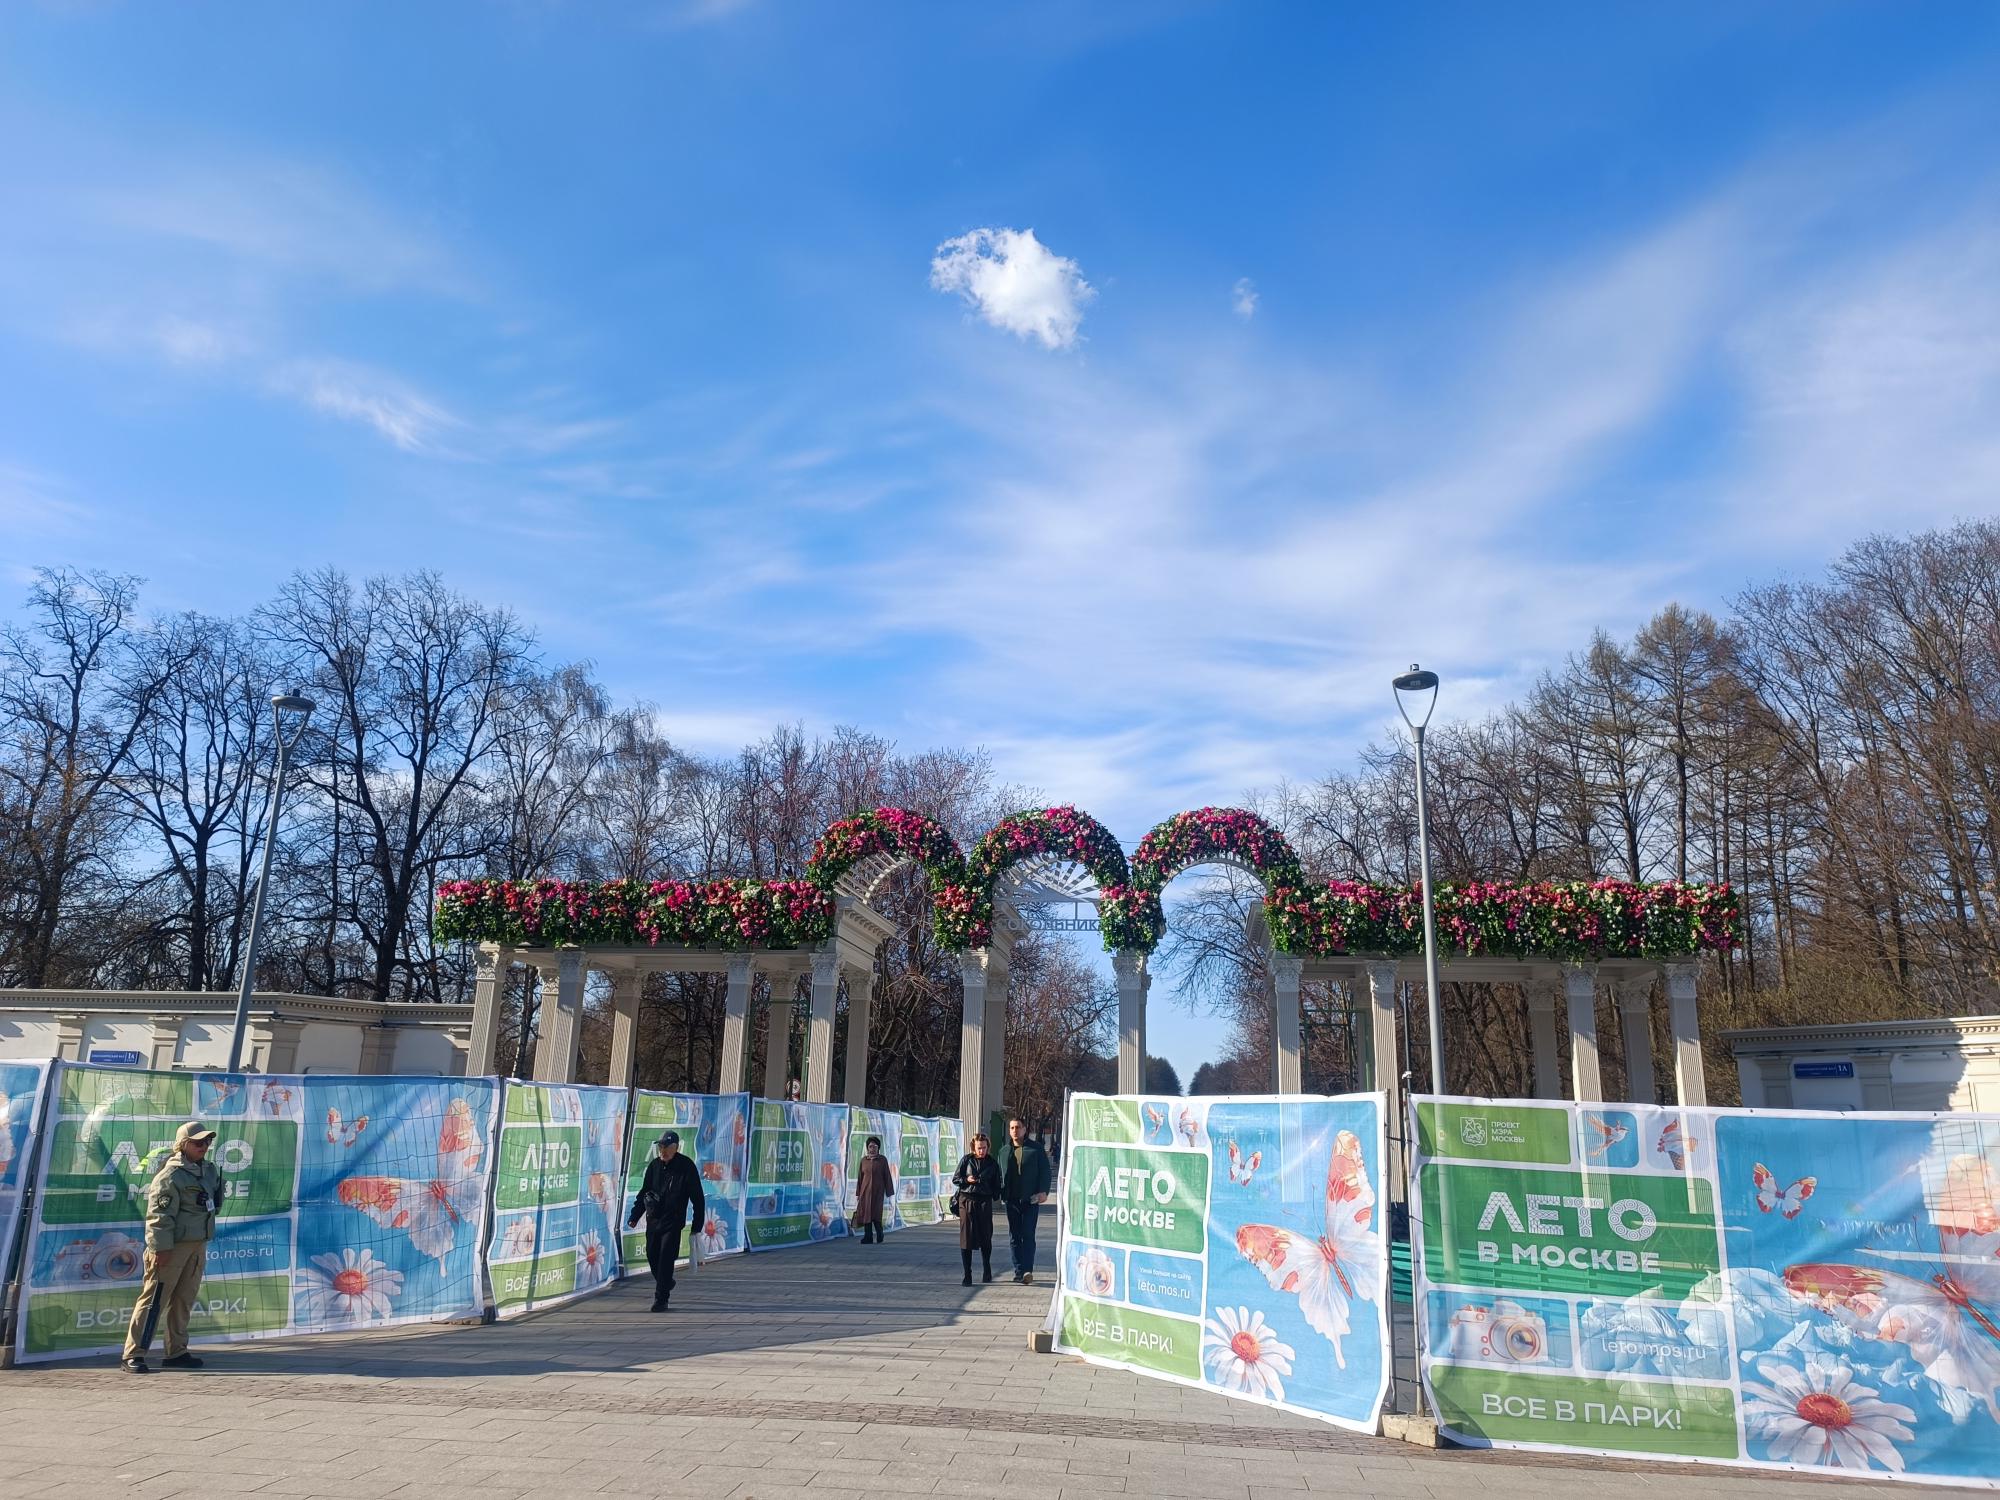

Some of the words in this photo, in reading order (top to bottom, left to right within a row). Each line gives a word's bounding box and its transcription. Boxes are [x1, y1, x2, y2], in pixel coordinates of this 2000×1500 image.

[521, 1141, 570, 1170] ЛЕТО
[767, 1140, 803, 1159] ЛЕТО
[765, 1163, 771, 1172] В
[97, 1184, 116, 1201] В
[519, 1177, 529, 1192] В
[531, 1173, 569, 1191] МОСКВЕ
[1088, 1166, 1176, 1204] ЛЕТО
[1085, 1203, 1099, 1220] В
[1103, 1205, 1175, 1230] МОСКВЕ
[1477, 1191, 1657, 1242] ЛЕТО
[205, 1247, 273, 1260] to.mos.ru
[1478, 1241, 1499, 1262] В
[1511, 1243, 1661, 1274] МОСКВЕ
[505, 1275, 530, 1292] ВСЕ
[1138, 1280, 1190, 1299] leto.mos.ru
[189, 1298, 247, 1317] АРК!
[1083, 1318, 1106, 1339] ВСЕ
[1110, 1325, 1124, 1342] В
[1128, 1328, 1173, 1355] ПАРК!
[1602, 1338, 1706, 1360] leto.mos.ru
[1482, 1393, 1548, 1420] ВСЕ
[1554, 1400, 1576, 1422] В
[1584, 1402, 1682, 1430] ПАРК!
